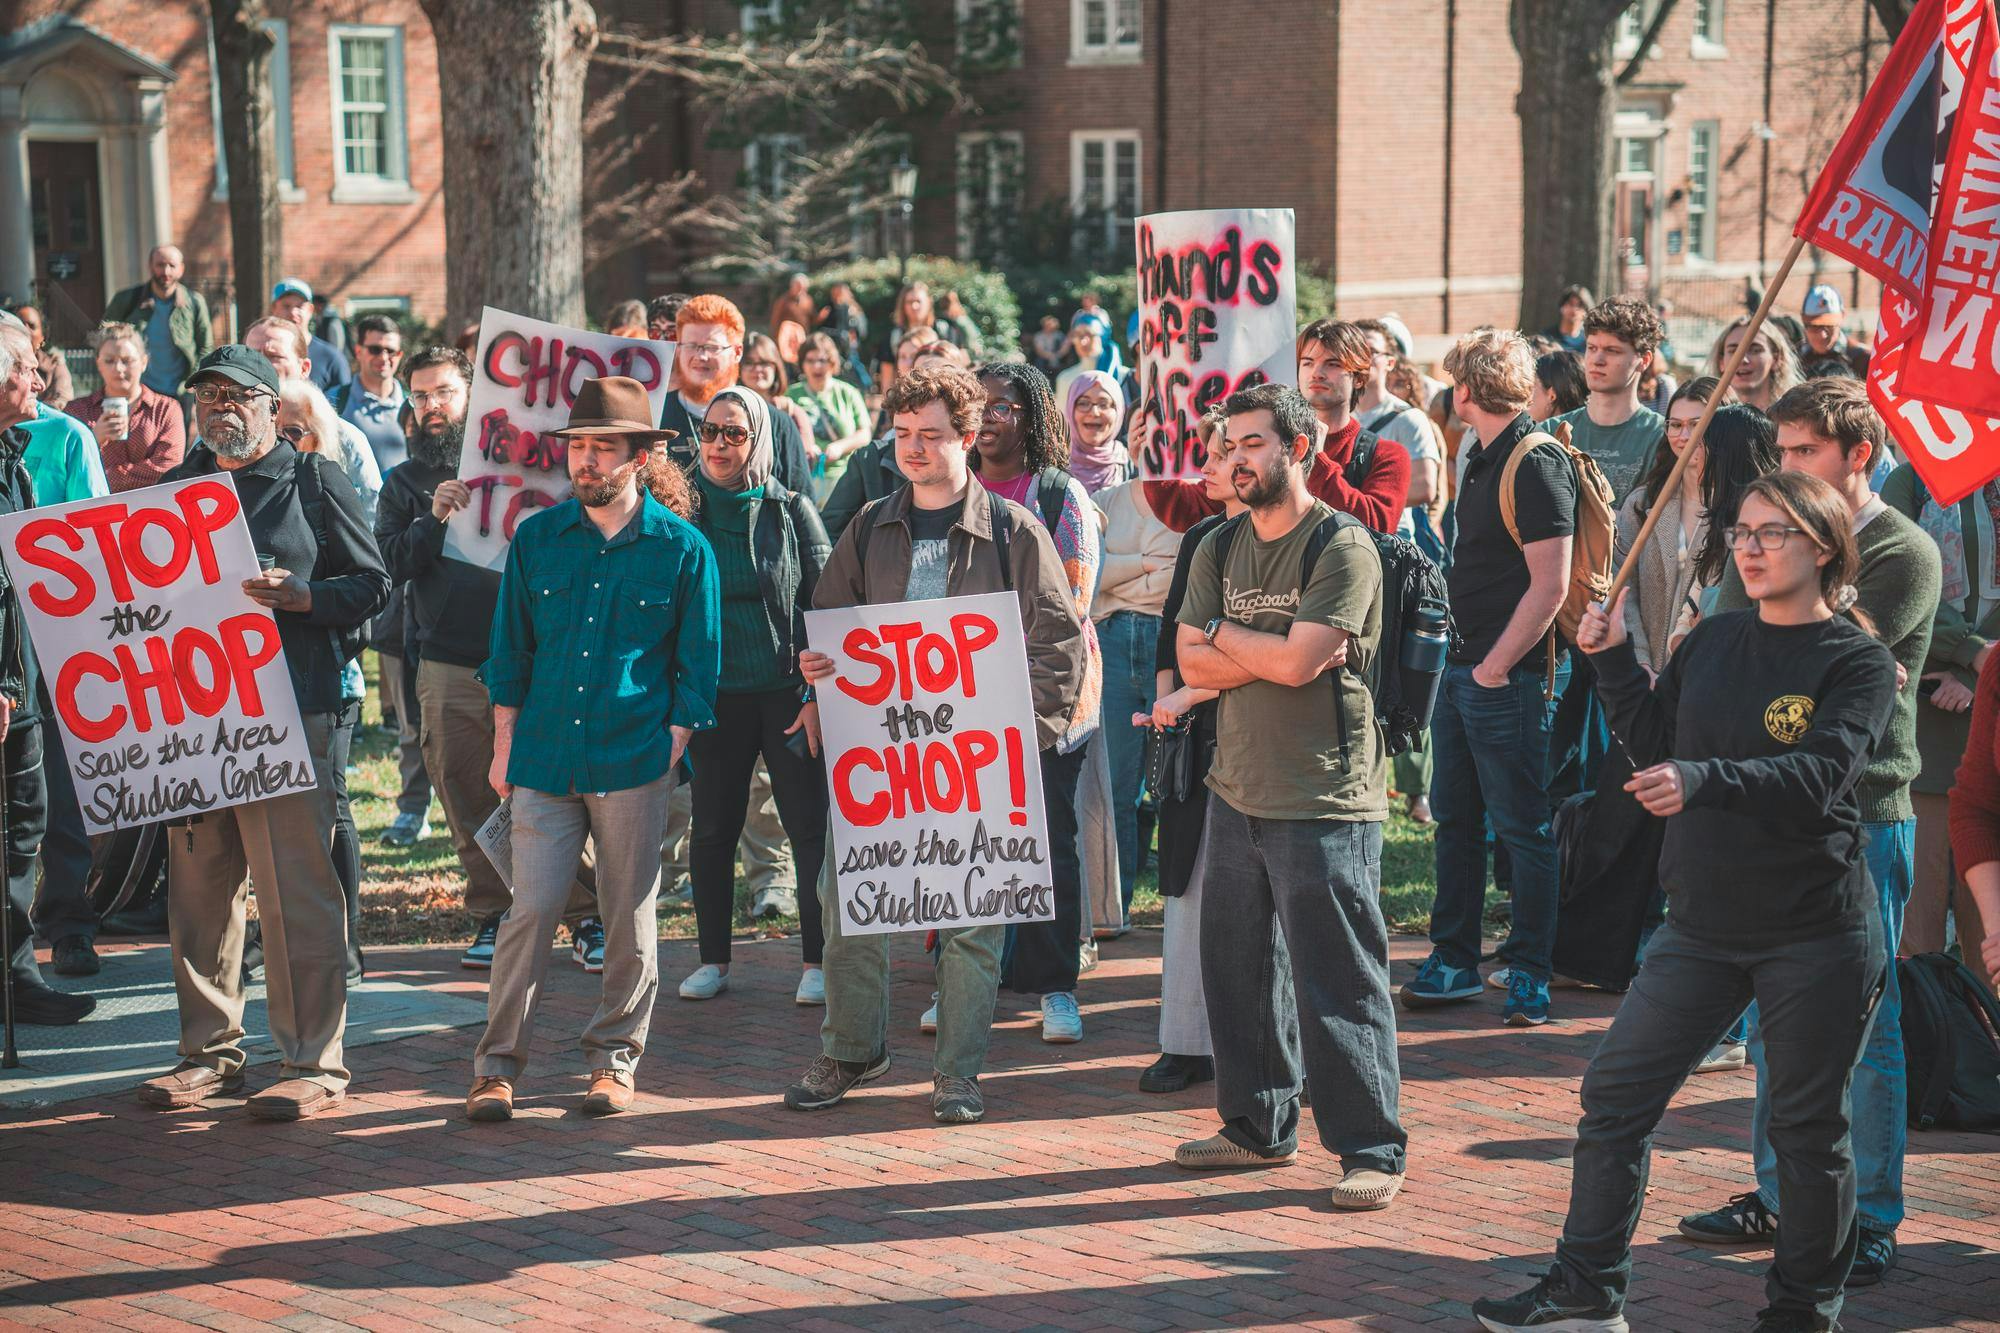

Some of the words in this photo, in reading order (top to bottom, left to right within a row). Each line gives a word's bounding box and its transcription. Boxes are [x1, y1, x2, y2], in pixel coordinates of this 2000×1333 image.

[1140, 224, 1281, 306] Hands
[1818, 190, 1928, 291] RAN
[1142, 301, 1219, 362] off
[484, 330, 662, 409] CHOP
[465, 475, 560, 542] TO
[15, 481, 240, 617] STOP
[100, 603, 172, 640] the
[55, 612, 282, 743] CHOP
[835, 613, 999, 706] STOP
[74, 743, 150, 780] save
[157, 729, 206, 765] the
[211, 717, 288, 755] Area
[880, 703, 954, 743] the
[84, 776, 217, 825] Studies
[220, 754, 317, 805] Centers
[832, 727, 1028, 827] CHOP!
[838, 837, 908, 876] save
[912, 829, 967, 868] the
[969, 818, 1046, 866] Area
[847, 877, 961, 927] Studies
[964, 865, 1053, 919] Centers
